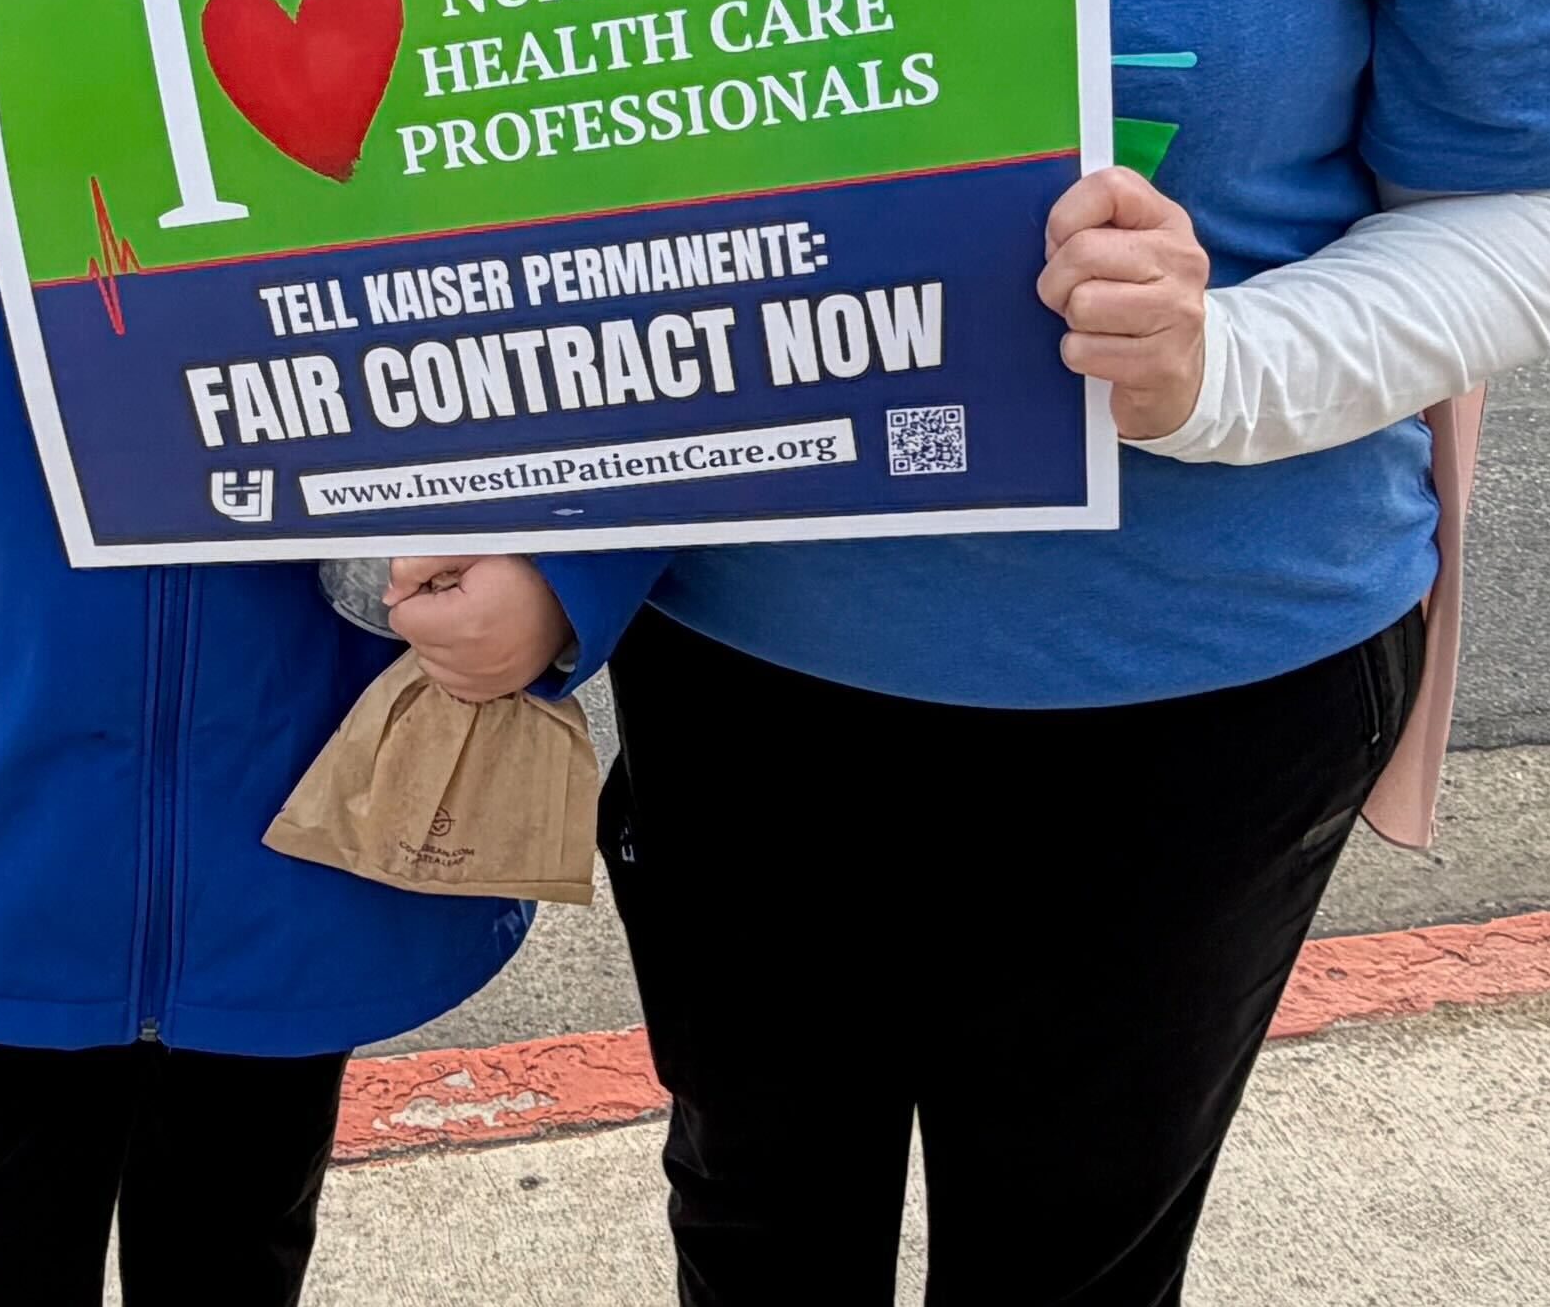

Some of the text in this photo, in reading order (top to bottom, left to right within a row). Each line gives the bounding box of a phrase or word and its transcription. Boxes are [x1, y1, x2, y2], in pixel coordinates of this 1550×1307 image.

[418, 10, 692, 96] HEALTH
[397, 53, 938, 174] PROFESSIONALS
[260, 223, 828, 335] TELL KAISER PERMANENTE:
[186, 283, 941, 446] FAIR CONTRACT NOW
[320, 434, 837, 506] www.InvestInPatientCare.org
